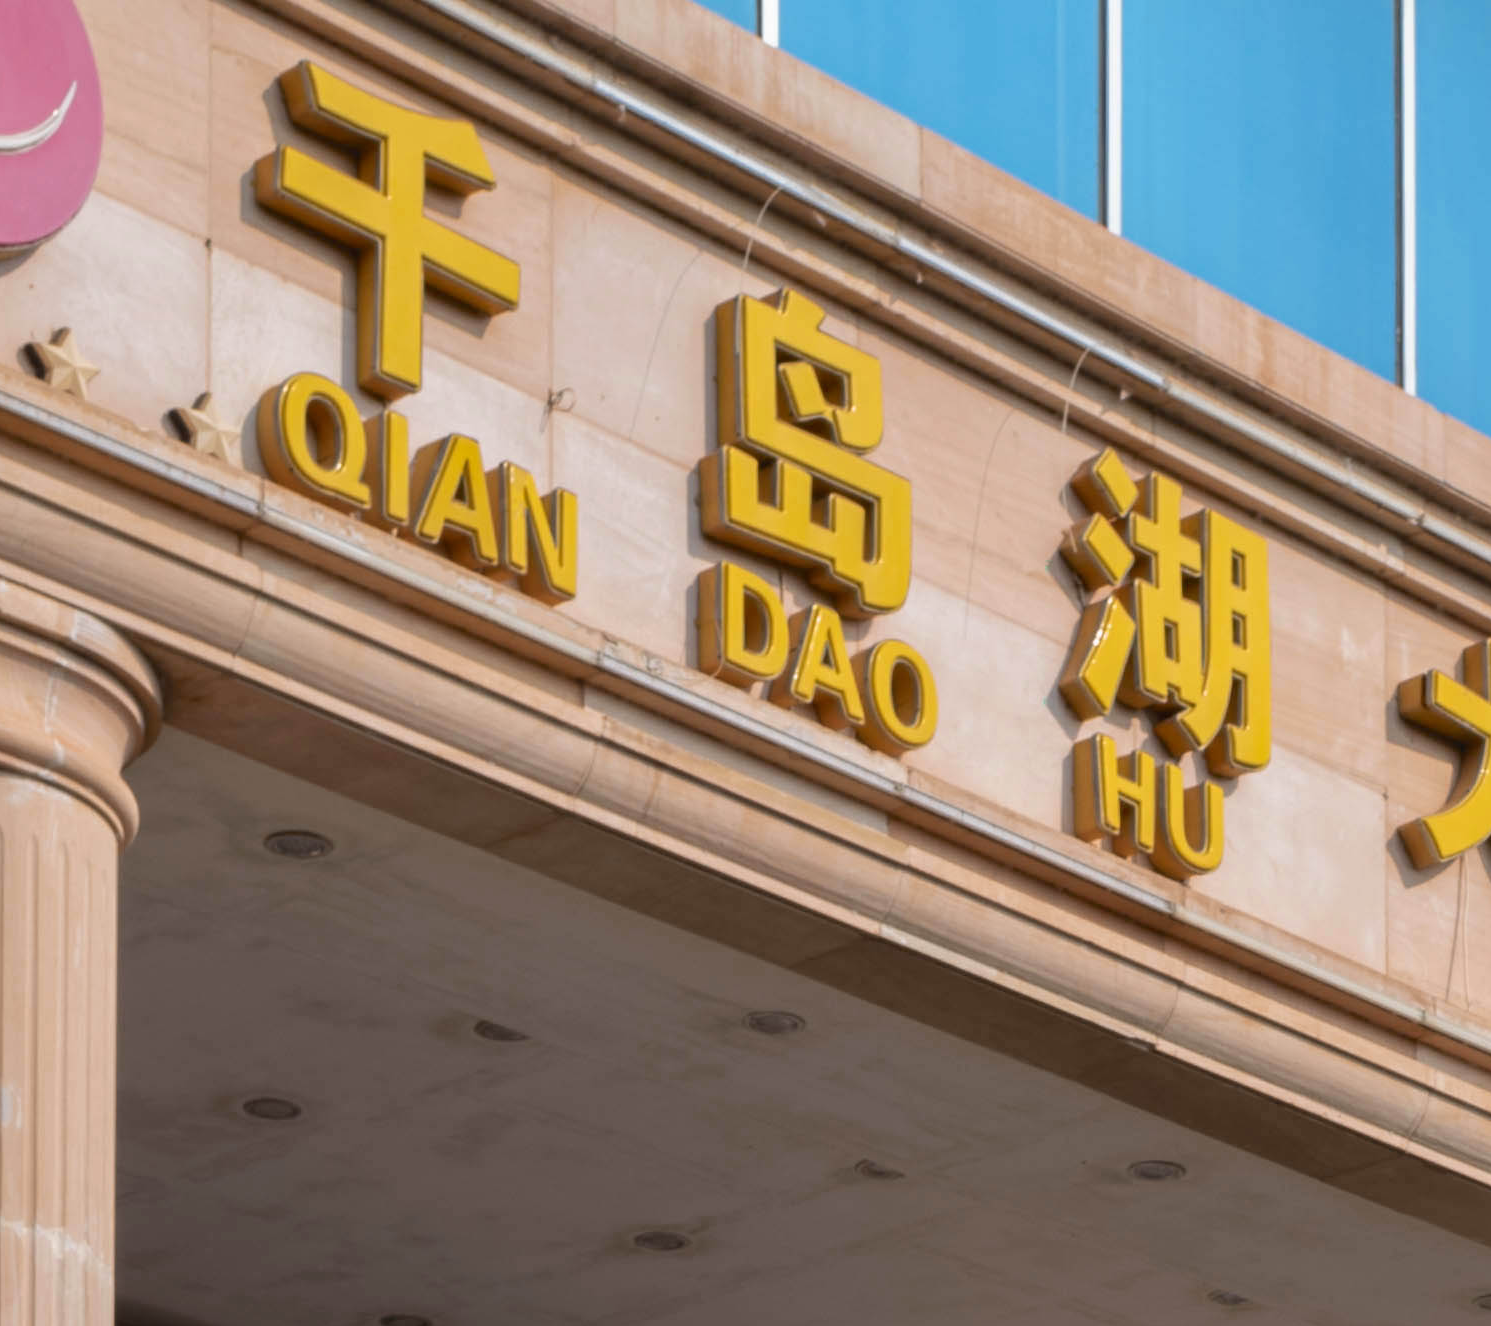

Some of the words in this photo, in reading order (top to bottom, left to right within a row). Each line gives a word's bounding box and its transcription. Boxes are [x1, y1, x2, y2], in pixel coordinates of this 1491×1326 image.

[261, 371, 577, 604] QIAN
[701, 561, 938, 754] DAO
[1075, 733, 1224, 878] HU
